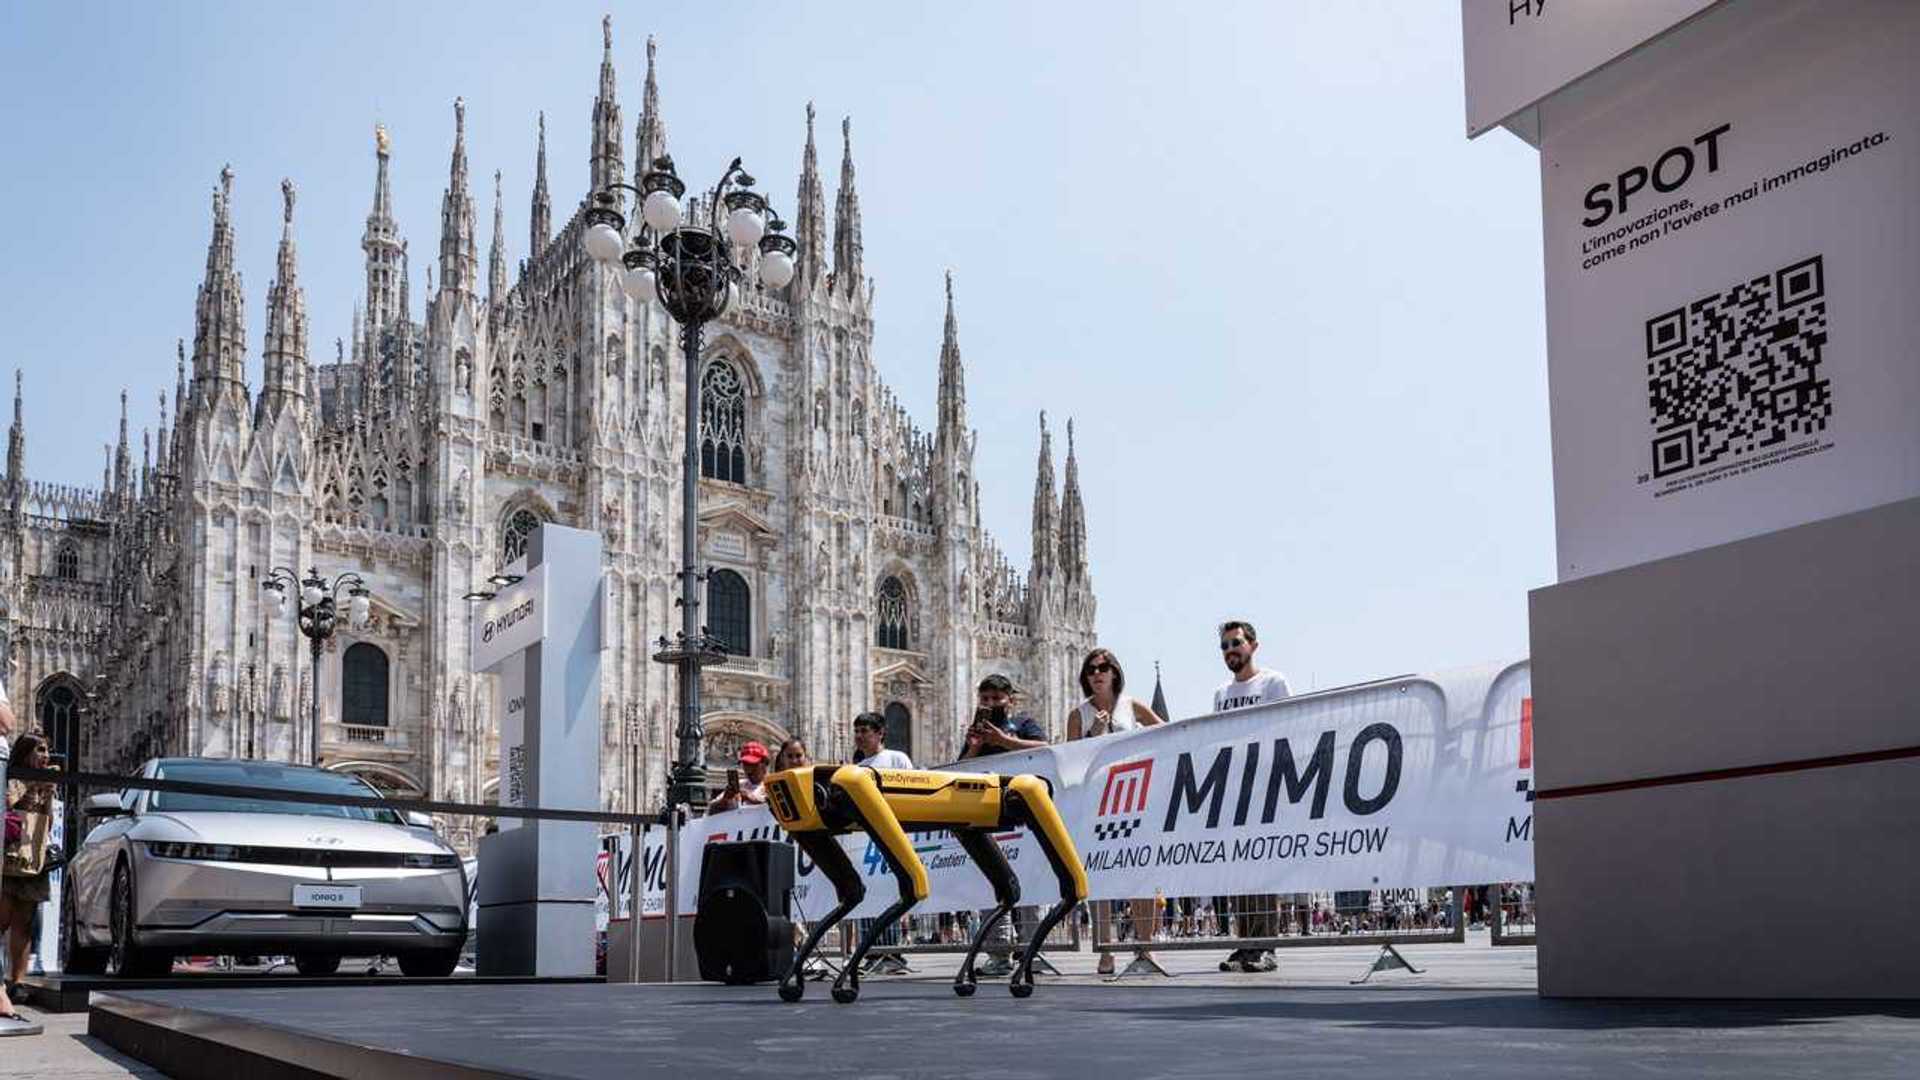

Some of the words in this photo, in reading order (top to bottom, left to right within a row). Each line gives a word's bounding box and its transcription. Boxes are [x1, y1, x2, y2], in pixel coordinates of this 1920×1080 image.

[1581, 122, 1731, 228] SPOT
[1582, 242, 1626, 270] come
[1629, 227, 1660, 250] non
[1663, 202, 1720, 235] l'avete
[1723, 181, 1758, 209] mai
[1762, 131, 1890, 193] immaginata.
[1582, 198, 1694, 254] L'innovazione,
[496, 598, 534, 633] HYUNDAI
[1162, 722, 1403, 832] MIMO
[1085, 845, 1152, 872] MILANO
[1155, 840, 1226, 867] MONZA
[1232, 831, 1309, 860] MOTOR
[1314, 826, 1390, 857] SHOW
[311, 893, 337, 902] IONIQ
